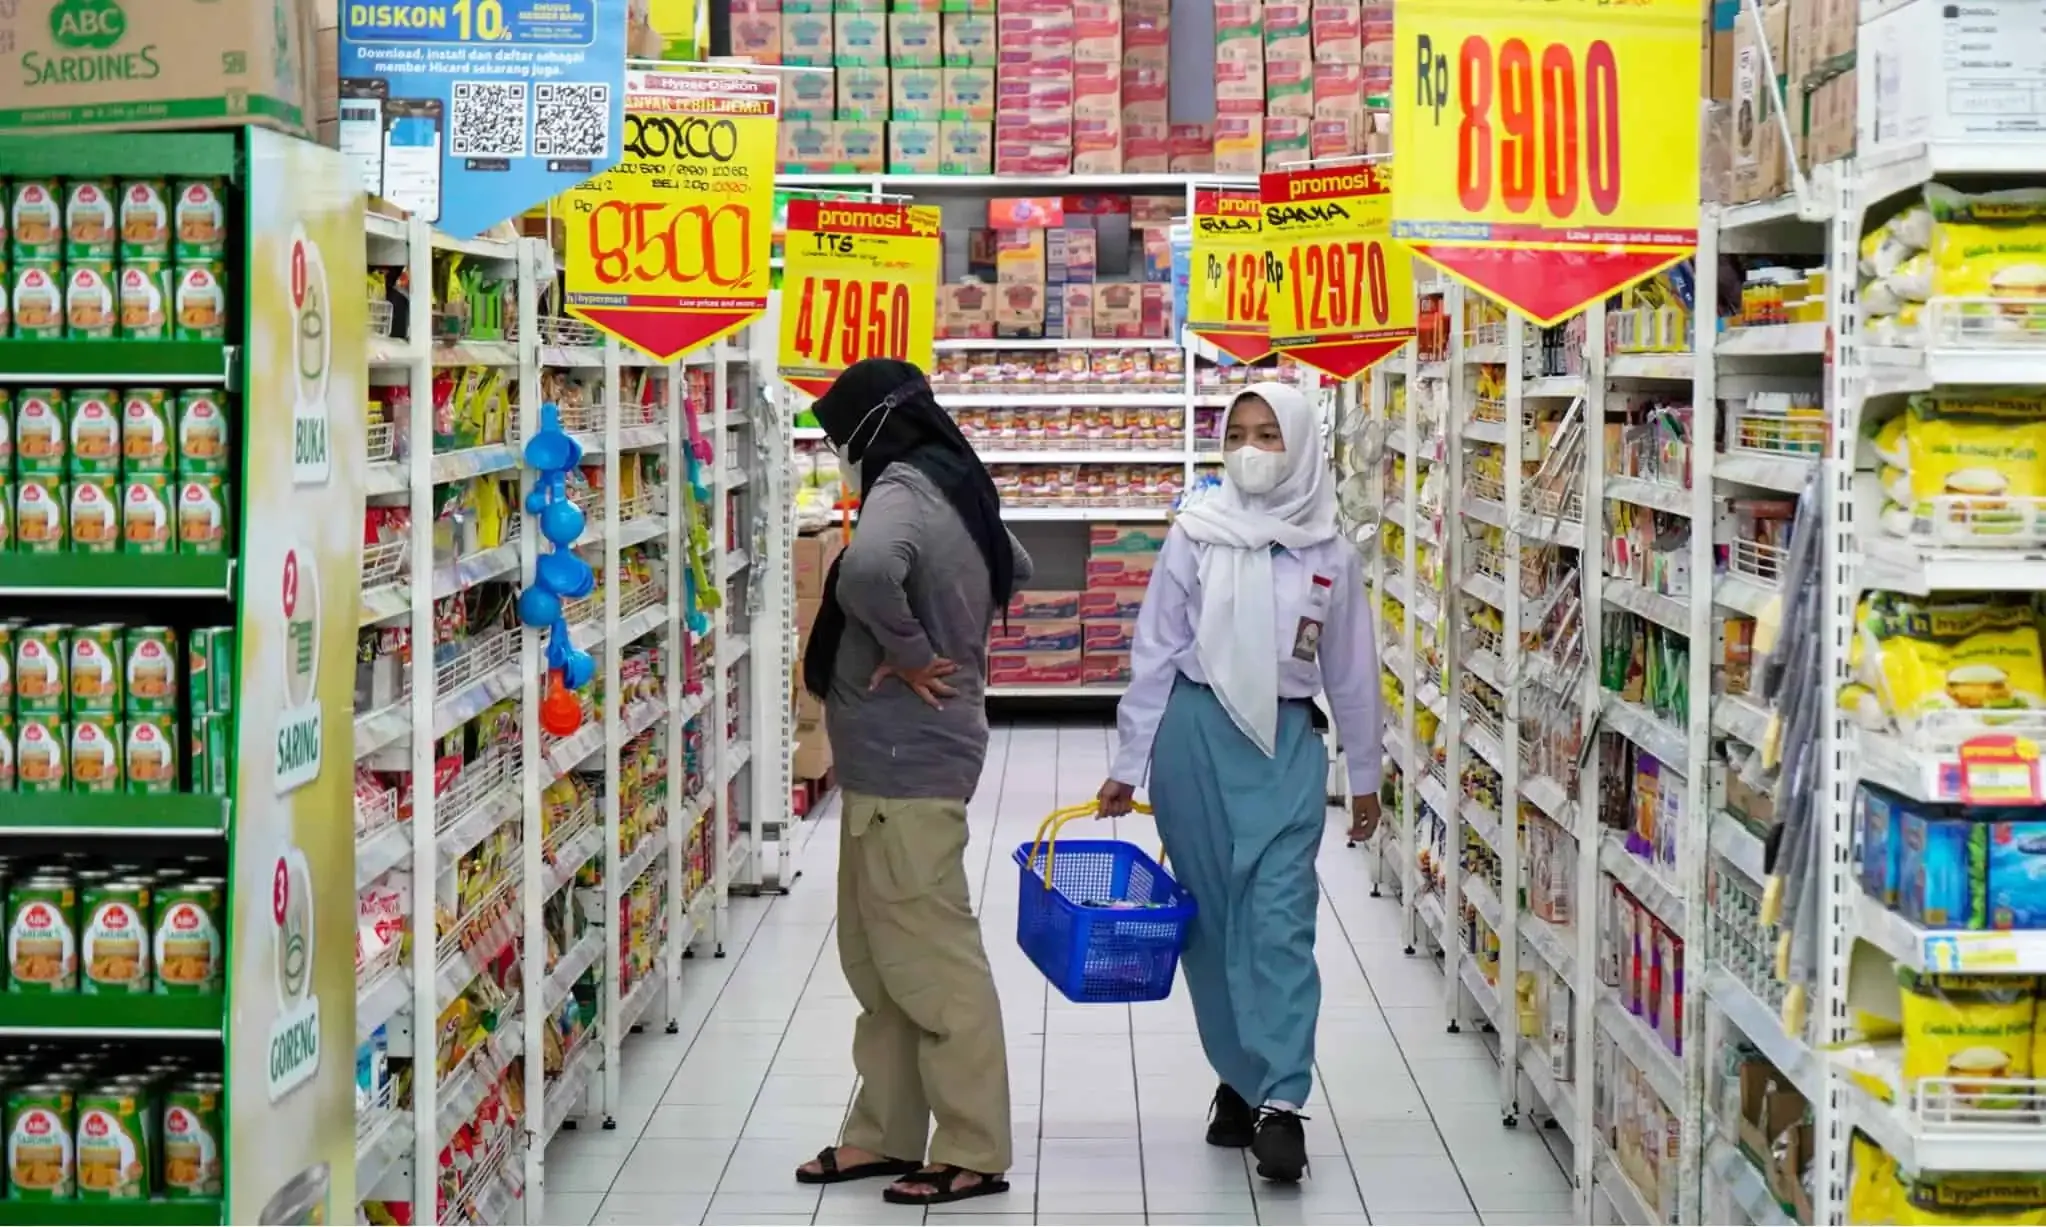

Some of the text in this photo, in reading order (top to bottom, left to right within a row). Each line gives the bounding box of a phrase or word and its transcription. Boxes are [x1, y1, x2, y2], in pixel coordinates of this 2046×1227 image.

[57, 8, 120, 37] ABC
[351, 5, 447, 28] DISKON
[21, 45, 160, 86] SARDINES
[357, 47, 424, 62] Download,
[427, 47, 467, 61] install
[469, 49, 491, 61] dan
[494, 49, 534, 62] daftar
[375, 61, 427, 74] member
[429, 61, 469, 74] Hicard
[472, 63, 530, 77] sekarang
[623, 114, 737, 162] ROYCO
[1417, 34, 1621, 219] Rp 8900
[1289, 168, 1370, 200] promosi
[817, 208, 902, 231] promosi
[813, 231, 854, 253] TTS
[1207, 253, 1222, 289] Rp
[1265, 241, 1390, 331] Rp 12970
[794, 276, 909, 366] 47950
[295, 418, 326, 465] BUKA
[285, 563, 295, 605] 2
[276, 716, 319, 775] SARING
[276, 870, 285, 911] 3
[270, 1011, 317, 1082] GORENG
